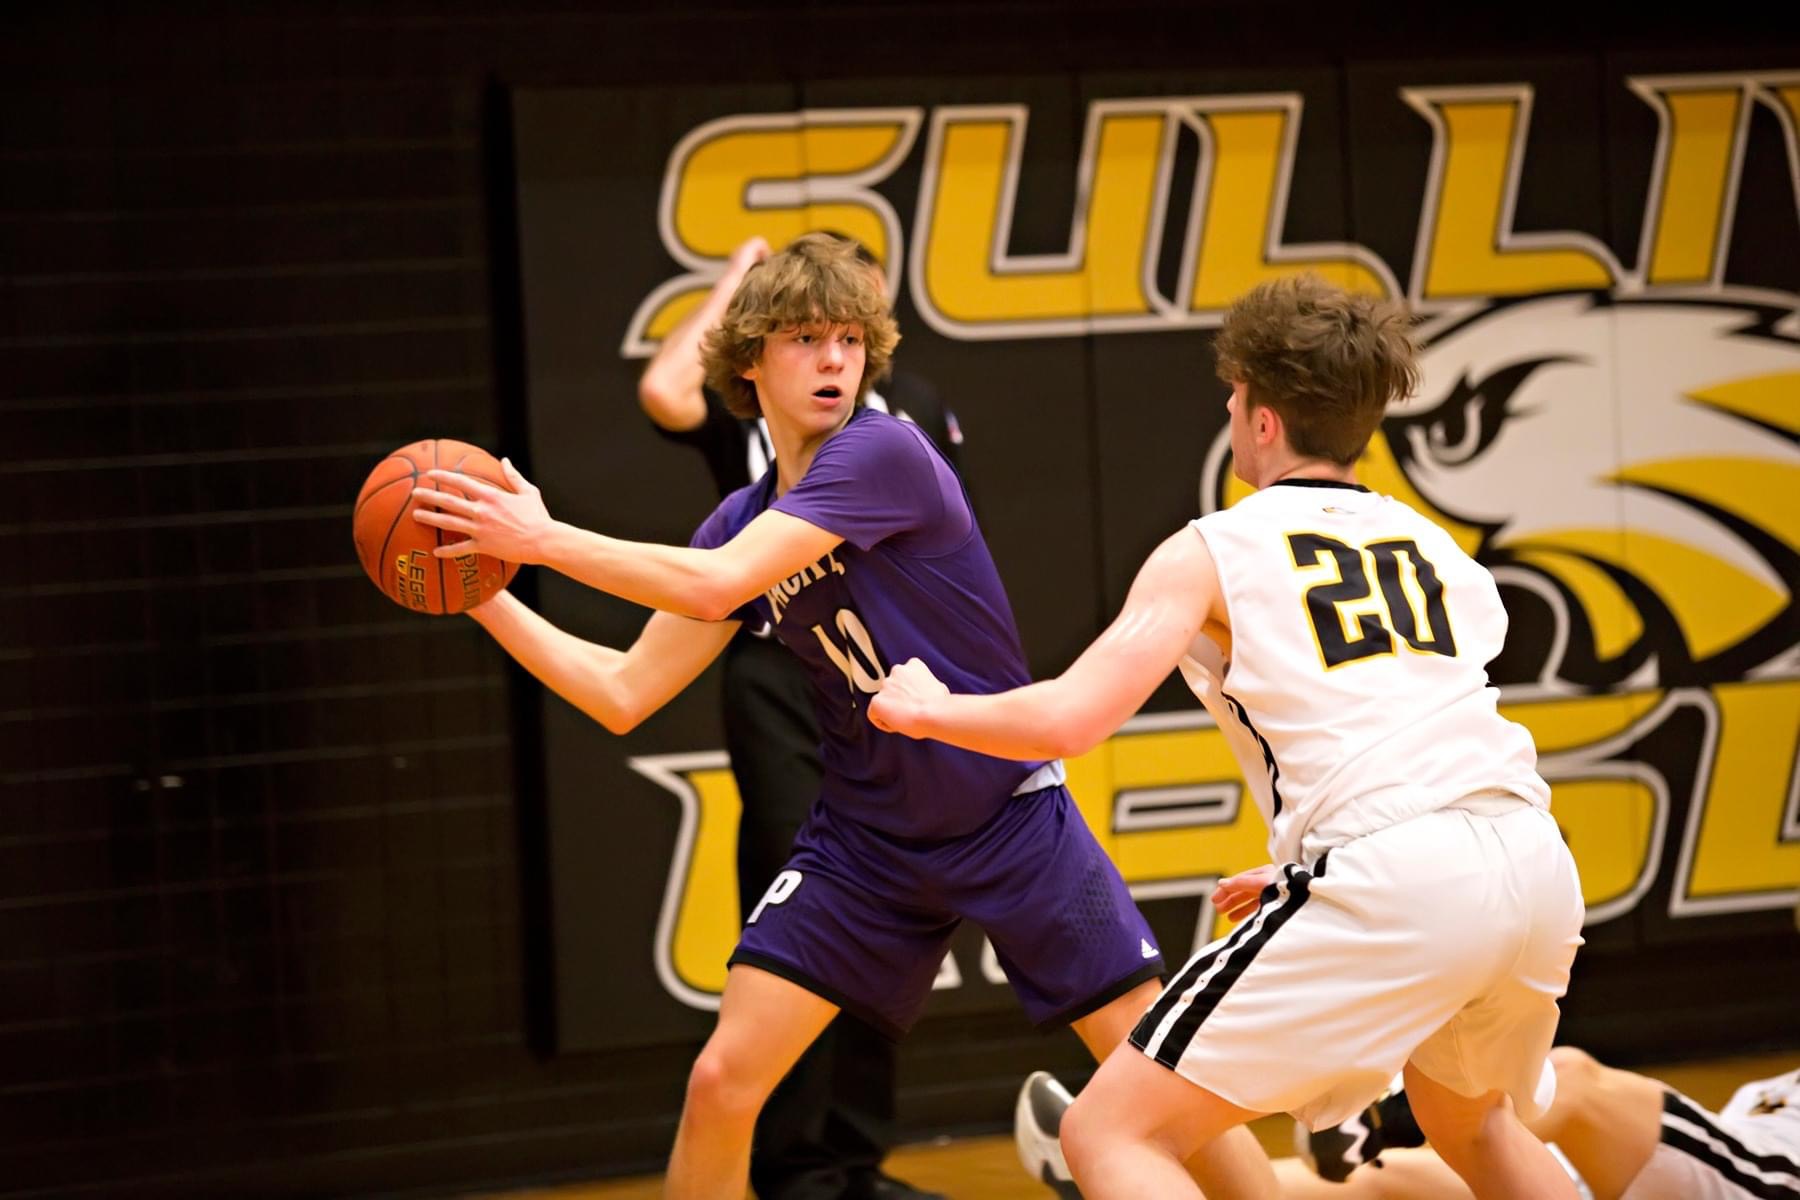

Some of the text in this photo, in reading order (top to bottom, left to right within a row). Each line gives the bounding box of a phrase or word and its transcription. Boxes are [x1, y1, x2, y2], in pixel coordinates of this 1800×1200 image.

[622, 70, 1800, 357] SULLI
[811, 608, 887, 693] 10
[1283, 531, 1457, 671] 20
[747, 869, 803, 924] P
